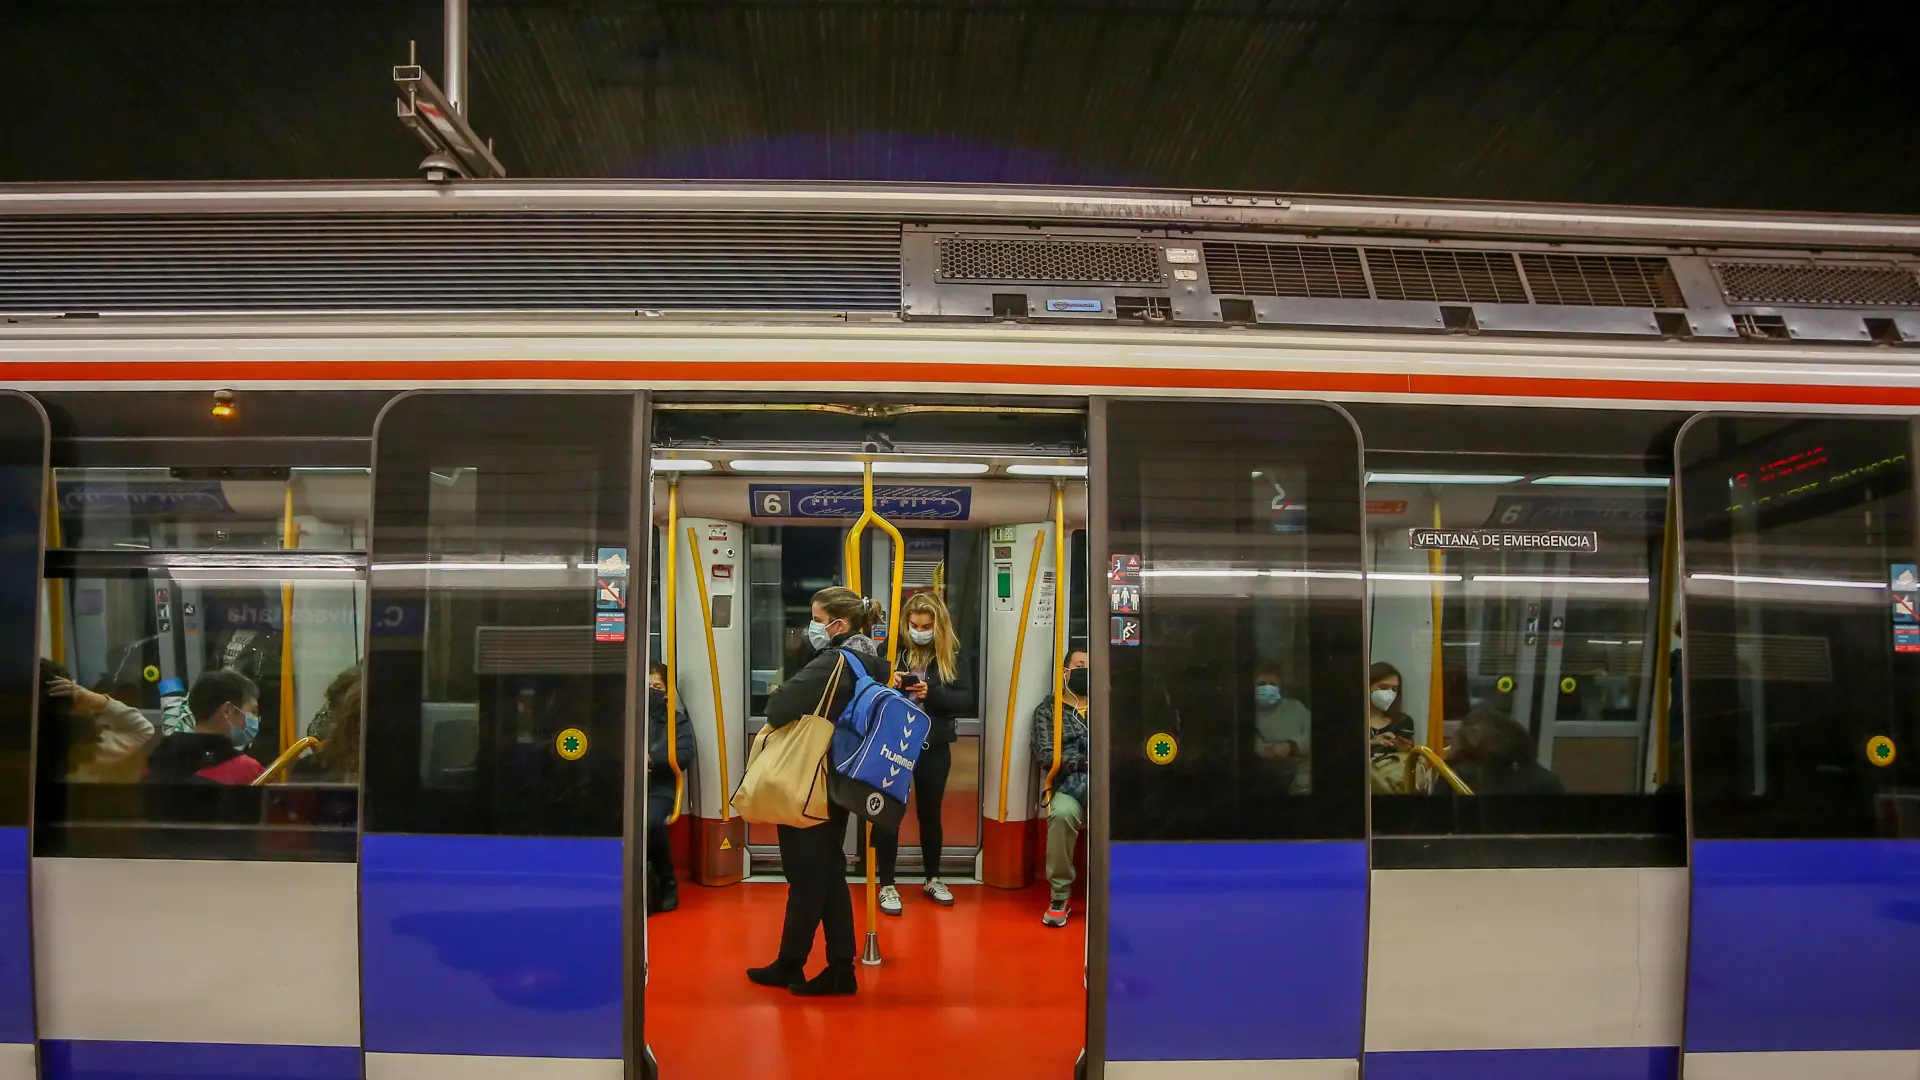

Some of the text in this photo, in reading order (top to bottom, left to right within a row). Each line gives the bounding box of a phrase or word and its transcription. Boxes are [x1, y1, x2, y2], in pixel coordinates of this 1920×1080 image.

[763, 494, 782, 513] 6
[1501, 505, 1522, 524] 6
[1417, 533, 1590, 547] VENTANA DE EMERGENCIA
[880, 743, 916, 771] hummel
